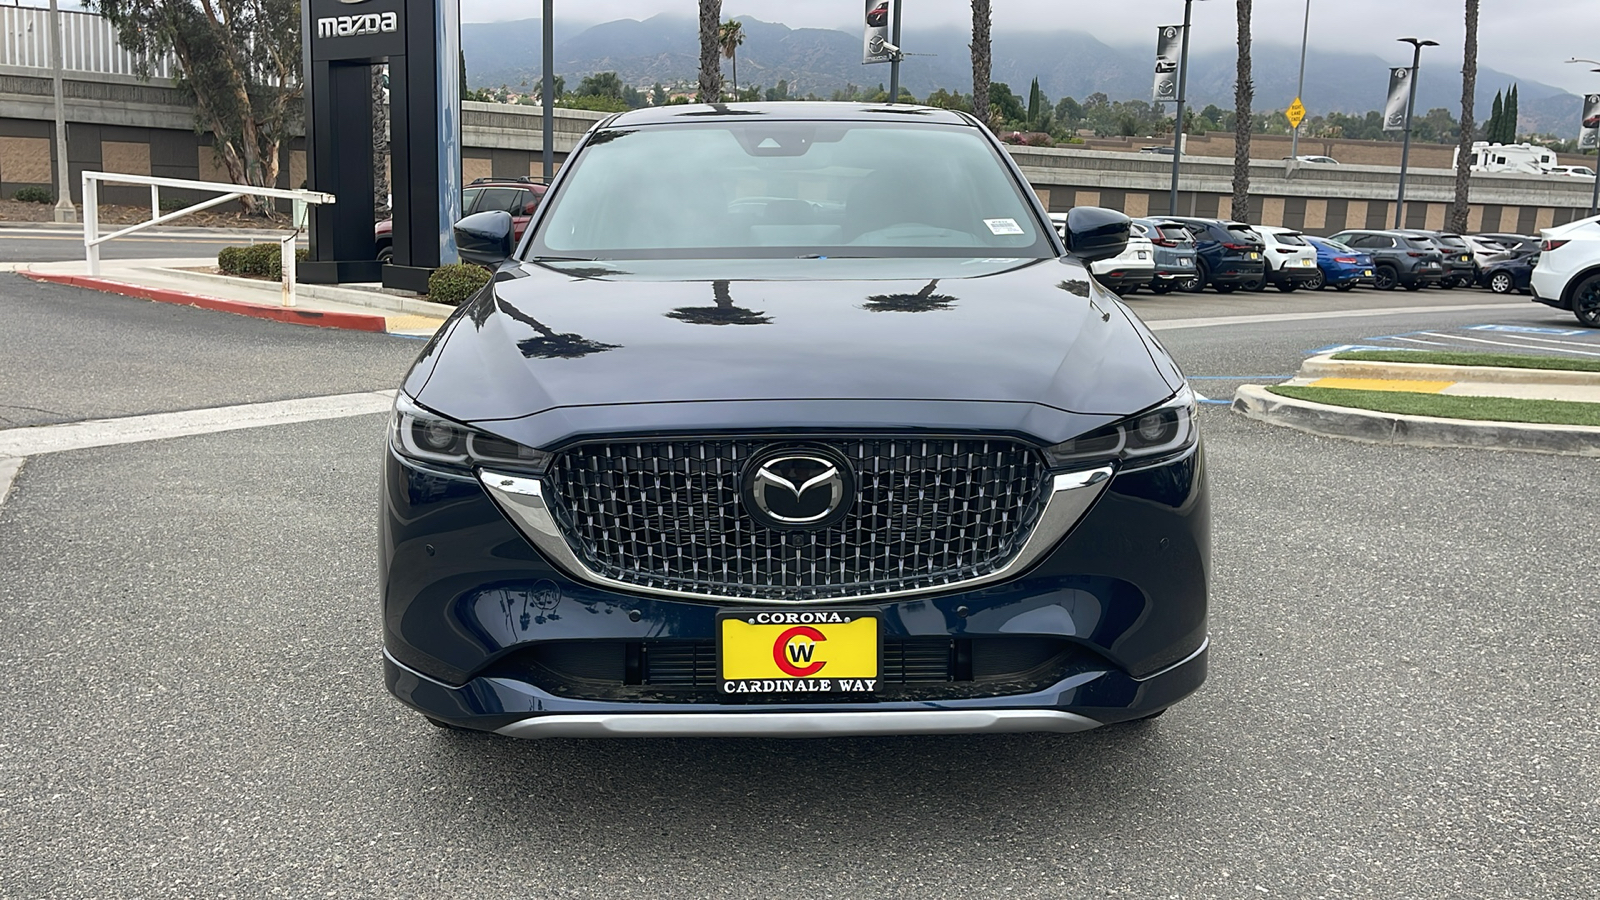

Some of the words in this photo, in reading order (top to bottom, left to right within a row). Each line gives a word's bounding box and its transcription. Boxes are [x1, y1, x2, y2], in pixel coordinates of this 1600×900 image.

[318, 11, 397, 38] mazda
[757, 612, 842, 624] CORONA
[723, 680, 831, 693] CARDINALE
[839, 680, 877, 692] WAY
